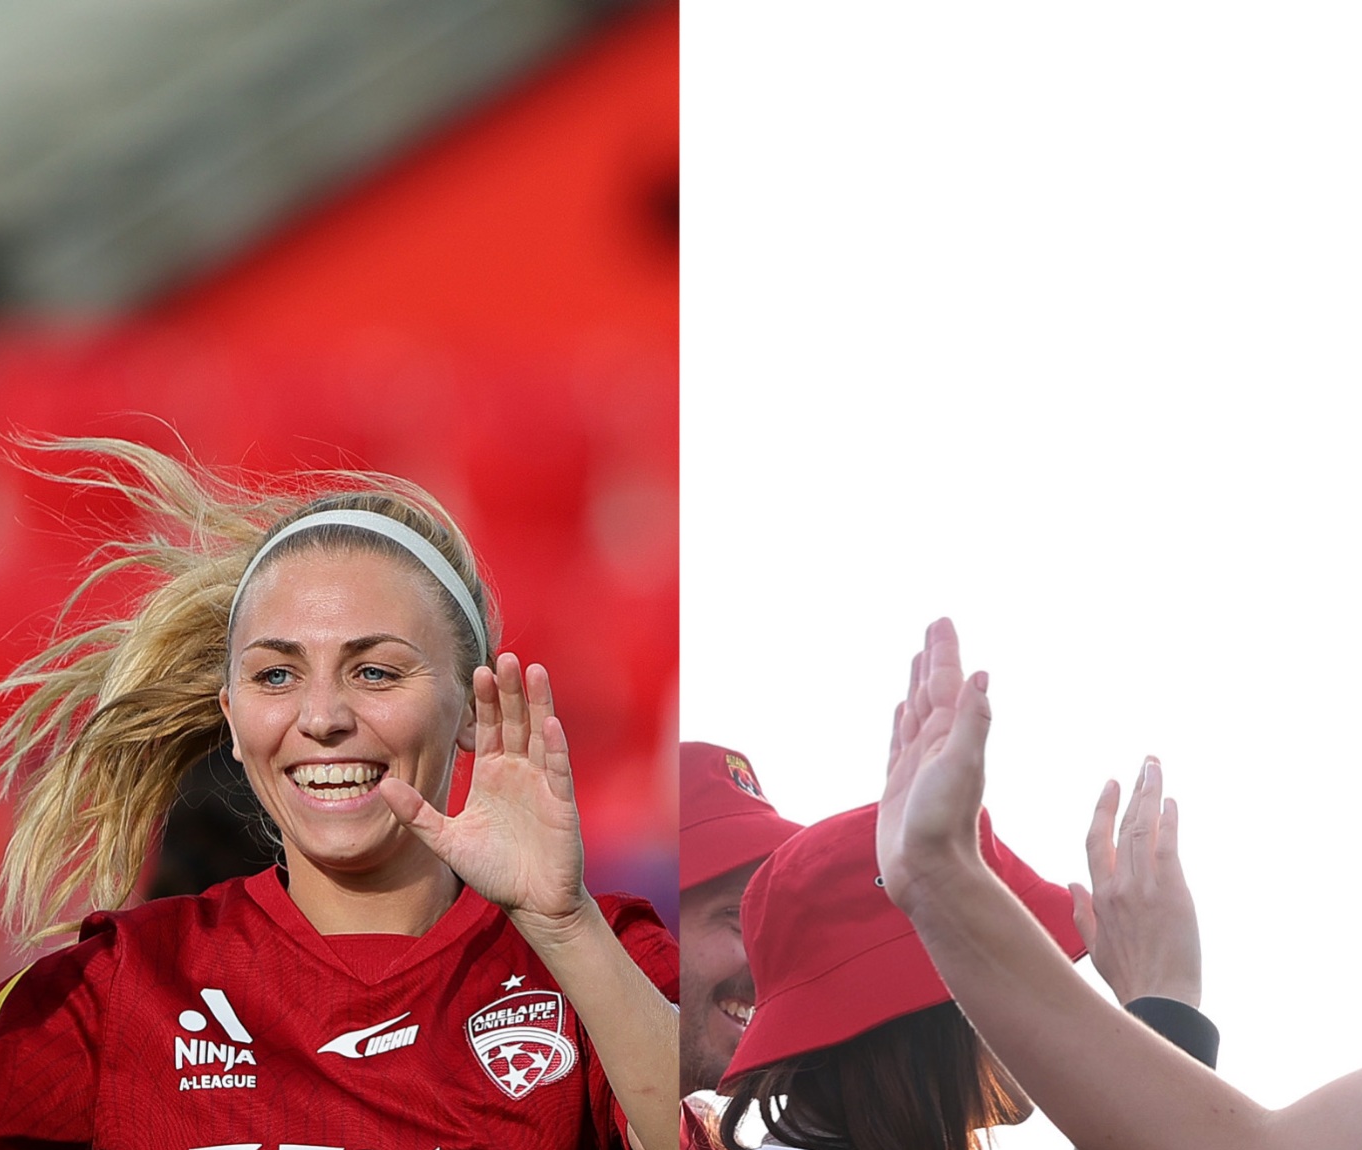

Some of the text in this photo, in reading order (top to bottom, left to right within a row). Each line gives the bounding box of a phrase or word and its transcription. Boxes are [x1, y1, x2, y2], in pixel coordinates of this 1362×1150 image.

[472, 1000, 557, 1027] ADELAIDE
[473, 1010, 556, 1032] UNITED F.C.
[174, 1035, 257, 1073] NINJA
[178, 1074, 257, 1092] A-LEAGUE
